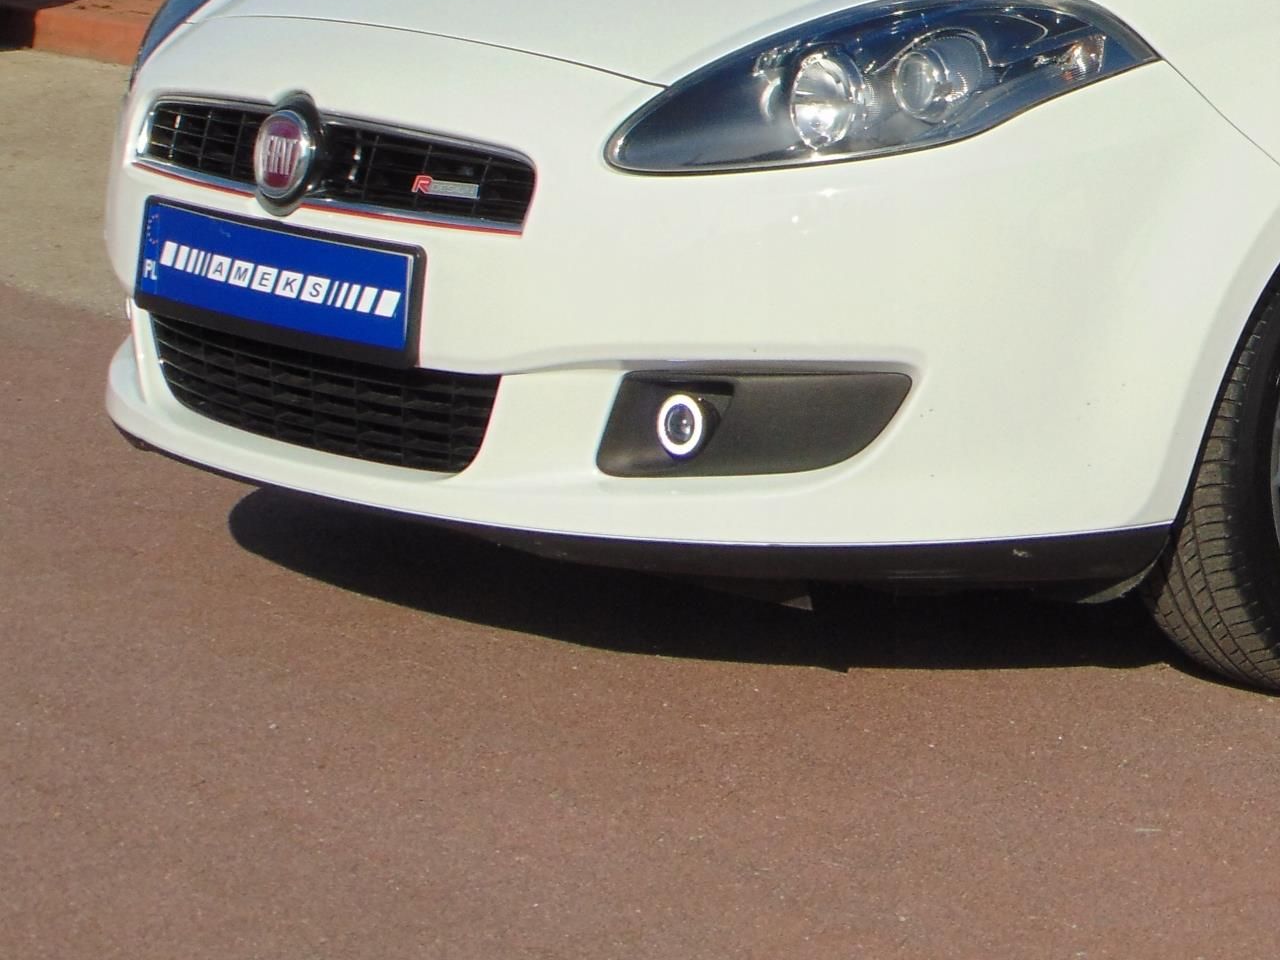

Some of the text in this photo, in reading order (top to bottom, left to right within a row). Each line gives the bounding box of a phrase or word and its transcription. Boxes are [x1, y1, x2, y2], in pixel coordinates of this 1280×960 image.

[264, 135, 299, 174] FIAT
[143, 259, 325, 300] PL AMEKS
